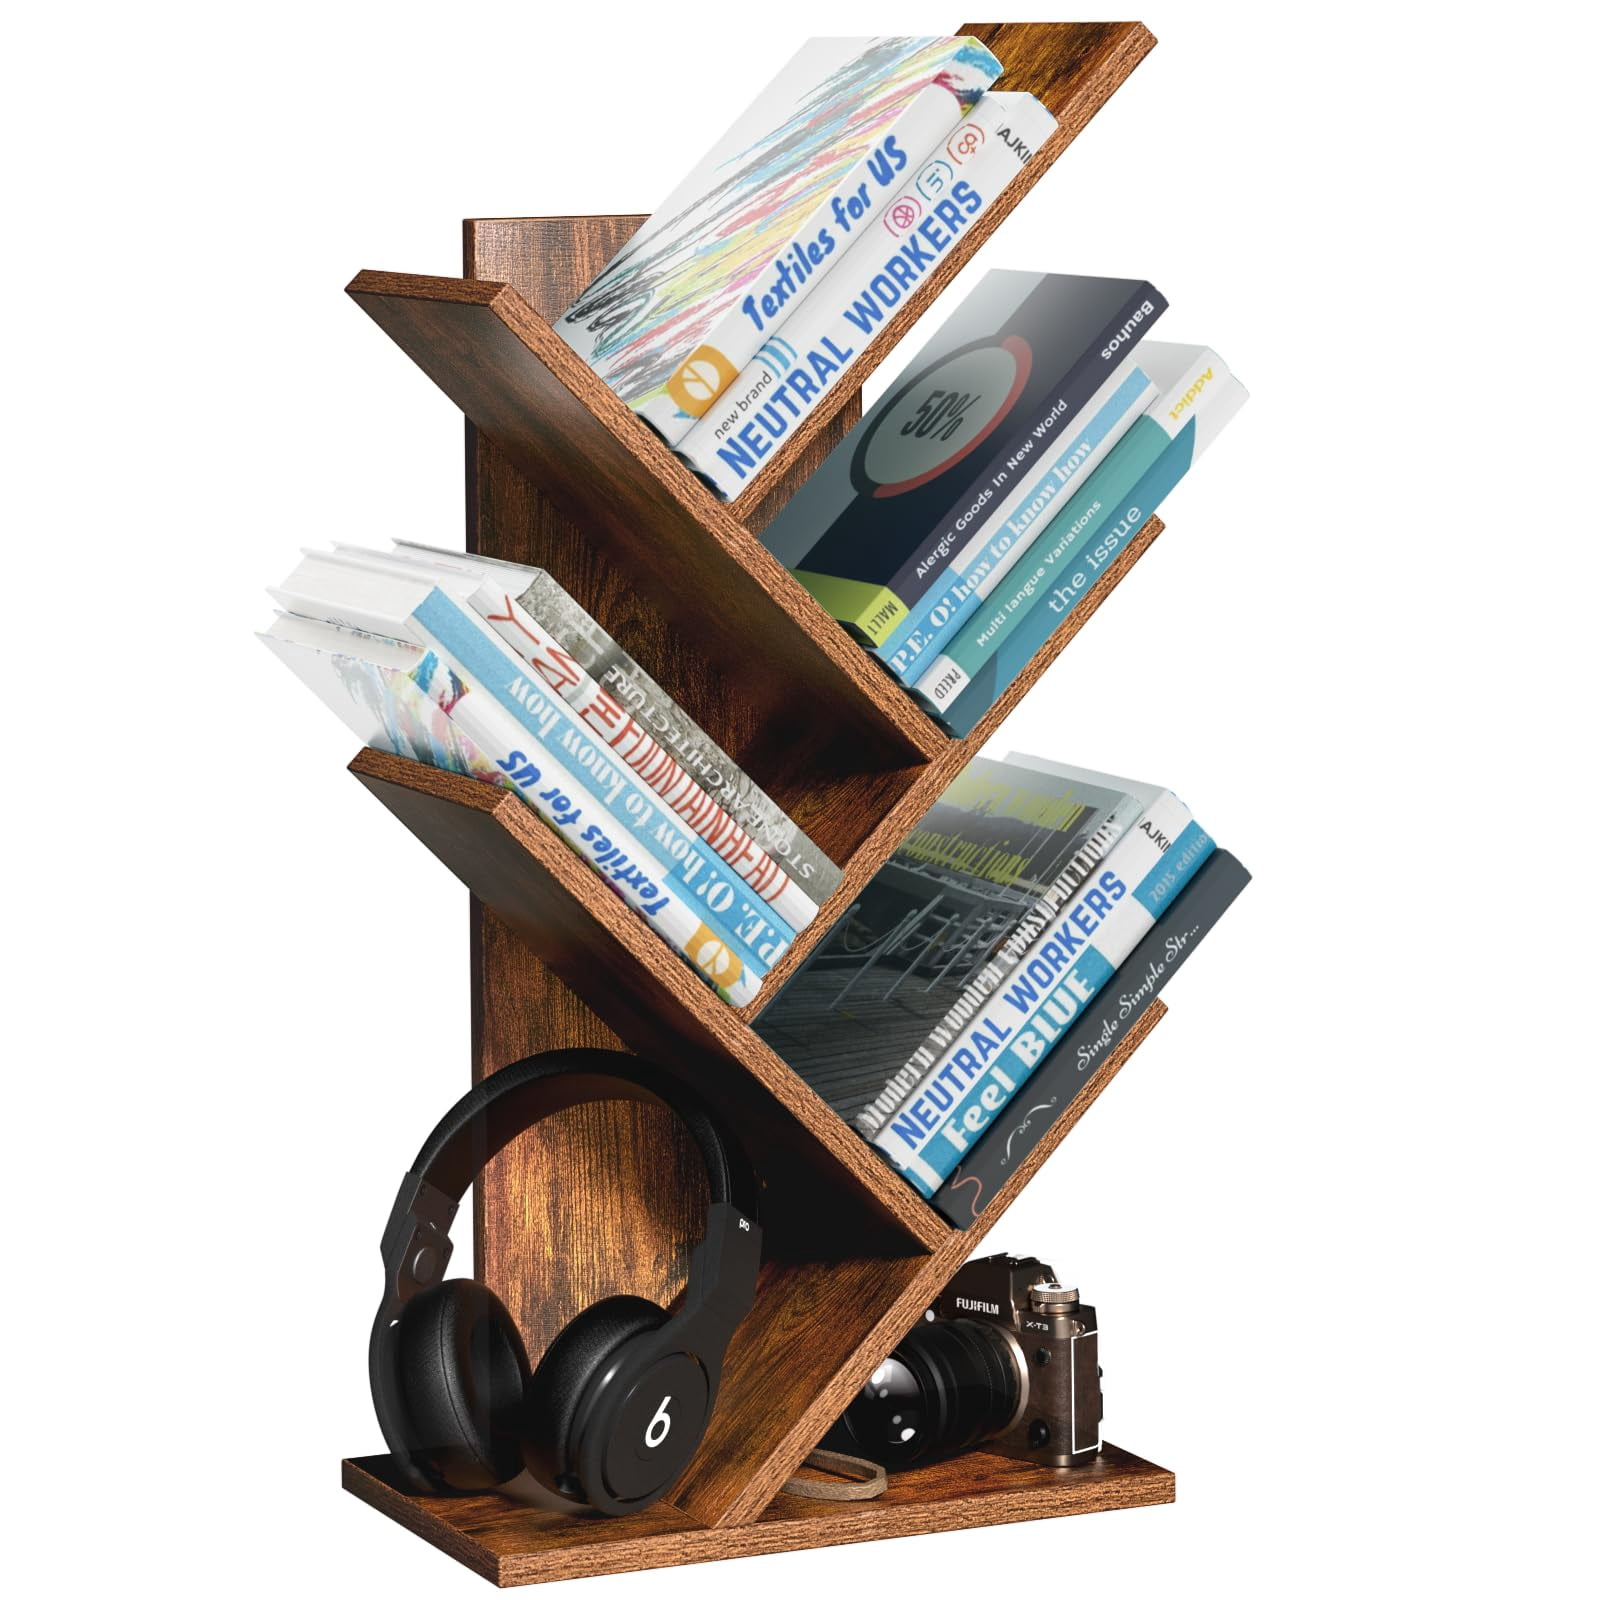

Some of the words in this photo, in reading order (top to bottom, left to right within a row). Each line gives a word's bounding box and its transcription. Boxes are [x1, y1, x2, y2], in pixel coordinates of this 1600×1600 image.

[742, 228, 835, 331] Textiles
[831, 183, 871, 232] for
[867, 135, 907, 187] US
[716, 336, 854, 480] NEUTRAL
[843, 180, 982, 335] WORKERS
[1101, 300, 1155, 360] Bauhos
[714, 413, 739, 440] new
[737, 371, 773, 411] brand
[900, 390, 981, 442] 50%
[1169, 367, 1214, 421] Addict
[915, 532, 956, 579] Alergic
[955, 488, 993, 531] Goods
[992, 472, 1008, 487] In
[1006, 441, 1034, 471] New
[1032, 399, 1068, 438] World
[890, 630, 933, 672] P.E.
[930, 597, 956, 627] O!
[951, 557, 991, 602] how
[989, 536, 1012, 562] to
[1007, 478, 1056, 535] know
[1053, 438, 1093, 483] how
[977, 613, 1007, 647] Multi
[1007, 567, 1045, 613] langue
[1044, 500, 1101, 565] Variations
[1049, 571, 1087, 613] the
[1085, 506, 1142, 571] issue
[504, 675, 561, 739] how
[934, 668, 962, 699] PREED
[496, 751, 542, 789] US
[556, 729, 627, 806] know
[604, 664, 750, 811] ARCHITECTURE
[539, 787, 582, 826] for
[625, 793, 653, 828] to
[581, 824, 670, 917] Textiles
[651, 822, 706, 885] how
[747, 812, 815, 879] STONE
[696, 870, 735, 913] O!
[1149, 872, 1176, 903] 2015
[734, 902, 790, 964] P.E.
[890, 1017, 1013, 1150] NEUTRAL
[1003, 870, 1127, 1015] WORKERS
[1077, 1019, 1119, 1071] Single
[1119, 963, 1166, 1020] Simple
[941, 1066, 1017, 1153] Feel
[956, 1297, 999, 1315] FUJIFILM
[1026, 1320, 1049, 1331] X-T3
